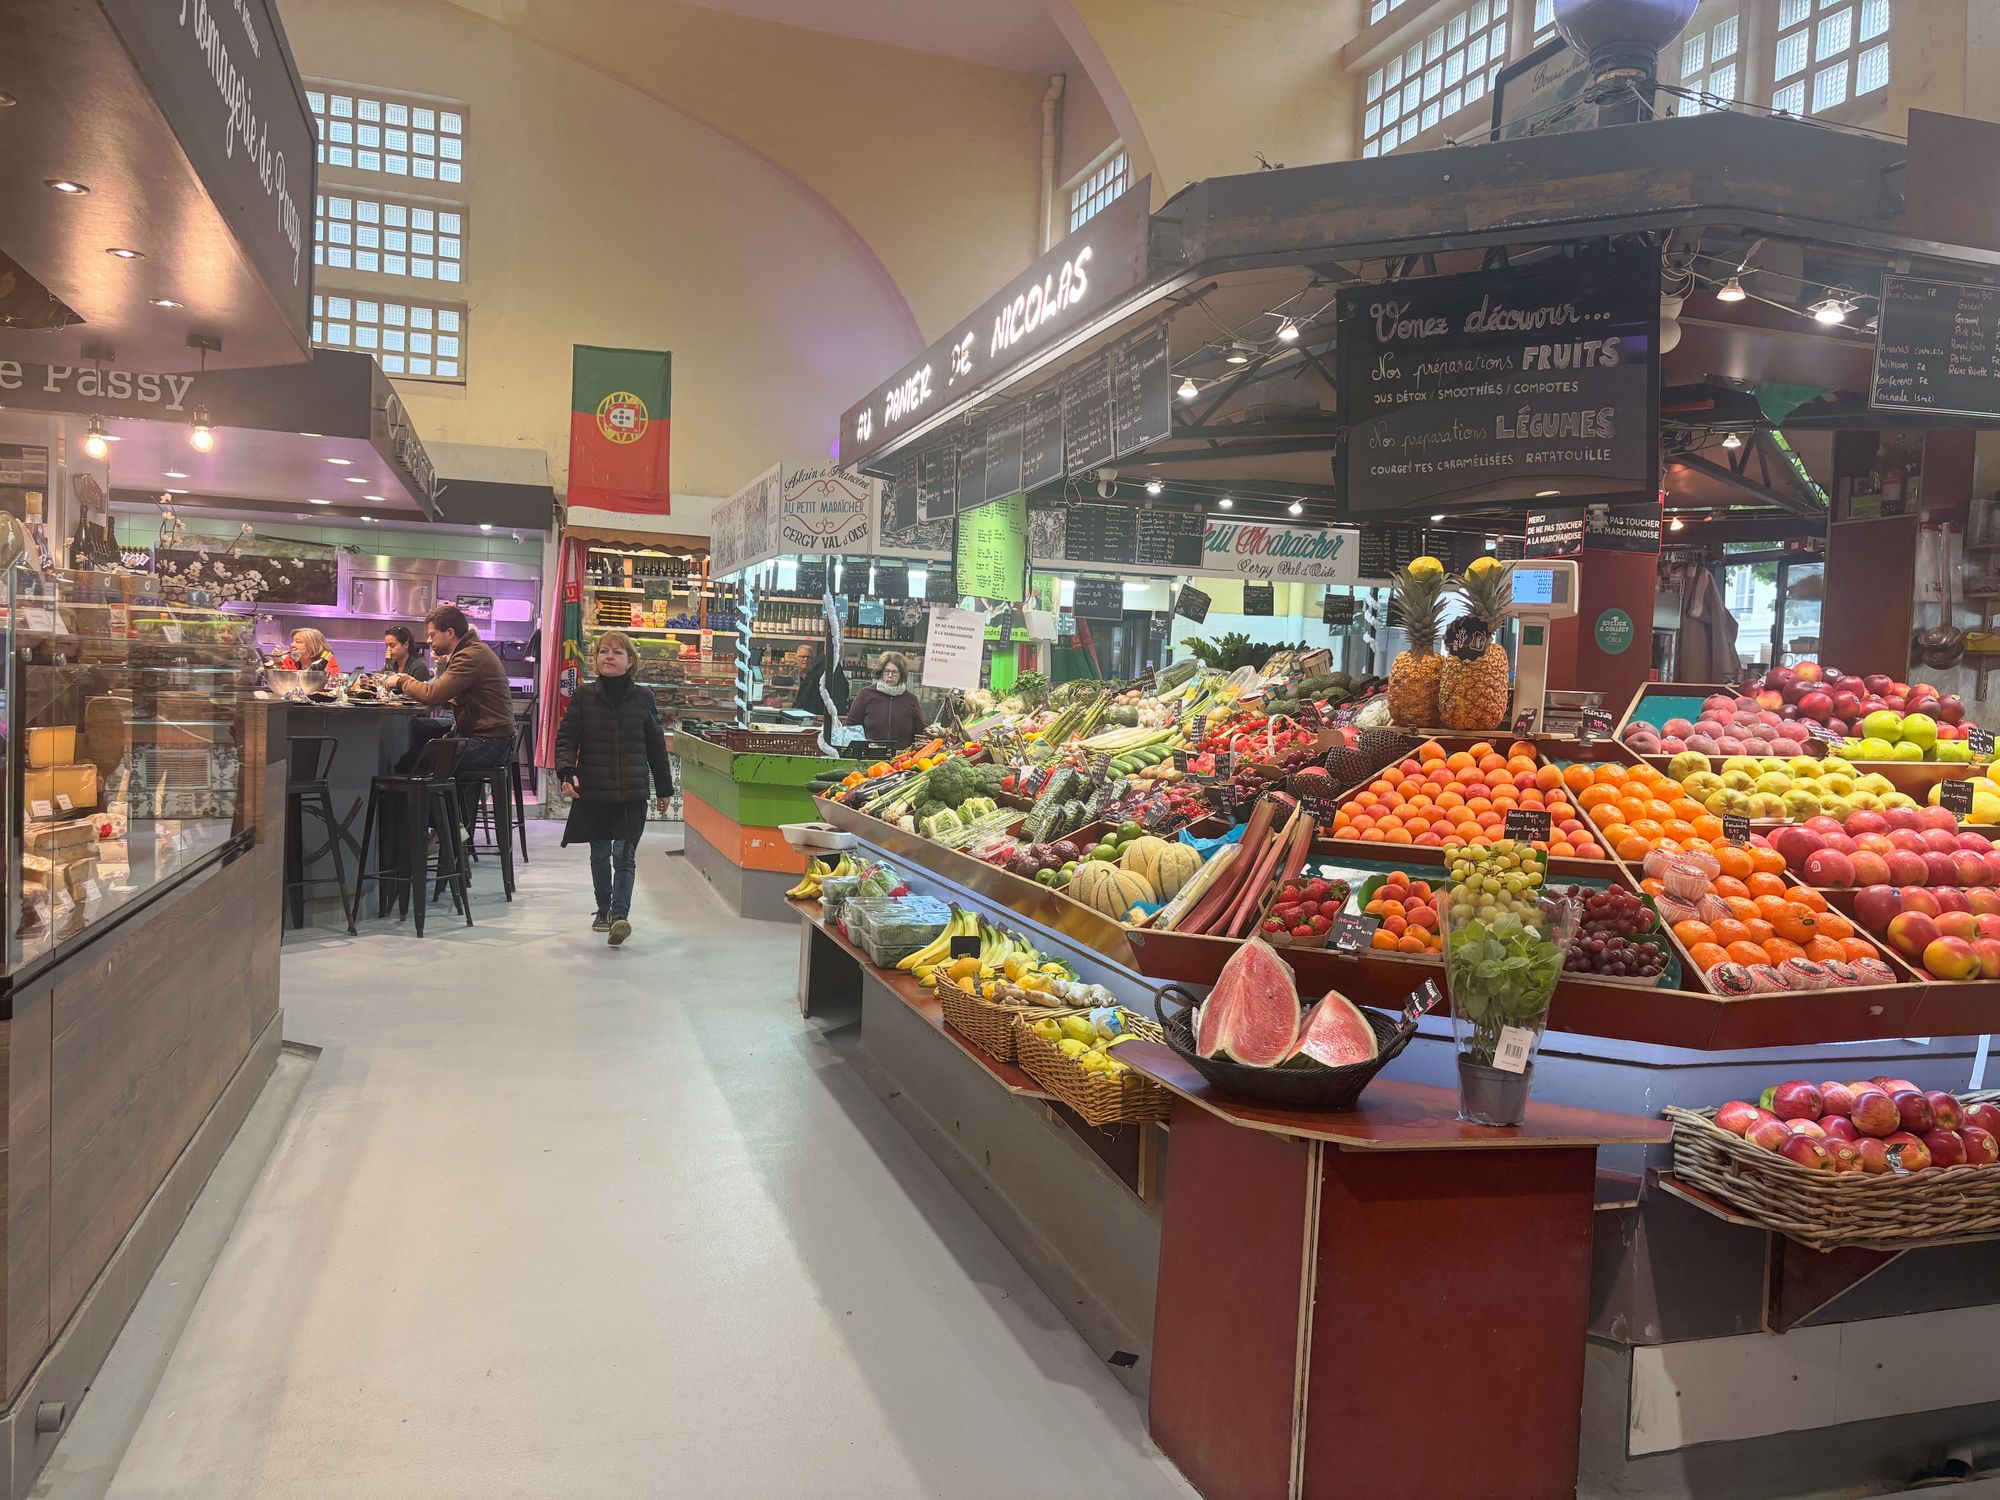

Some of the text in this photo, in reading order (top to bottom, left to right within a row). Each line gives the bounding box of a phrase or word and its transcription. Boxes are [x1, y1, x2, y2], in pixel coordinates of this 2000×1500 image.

[260, 121, 275, 197] de
[275, 151, 301, 287] Passy
[1927, 287, 1937, 297] FR
[1957, 299, 1984, 312] Golden
[1369, 300, 1449, 343] Venez
[1955, 312, 1979, 326] Granny
[856, 245, 1093, 444] AU PANIER DE NICOLAS
[1371, 336, 1621, 390] Nos préparations FRUITS
[1916, 362, 1927, 372] FR
[42, 363, 195, 411] Passy
[1919, 376, 1929, 386] FR
[1374, 393, 1394, 405] JUS
[1396, 389, 1428, 404] DÉTOX
[1437, 381, 1504, 401] SMOOTHIES
[1513, 380, 1579, 395] COMPOTES
[1877, 387, 1910, 402] Grenade
[1369, 420, 1397, 450] Nos
[1495, 404, 1617, 441] LÉGUMES
[1437, 454, 1515, 473] CARAMÉLISÉES
[1526, 445, 1612, 465] RATATOUILLE
[784, 467, 819, 492] Alain
[783, 498, 865, 514] AU PETIT MARAÎCHER
[1527, 514, 1546, 525] MERCI
[1527, 520, 1583, 536] DE NE PAS TOUCHER
[1609, 516, 1624, 526] PAS
[1625, 517, 1660, 529] TOUCHER
[782, 526, 819, 549] CERGY
[821, 536, 842, 549] VAL
[1235, 523, 1344, 561] Maraîcher
[1532, 536, 1539, 545] LA
[1539, 531, 1582, 544] MARCHANDISE
[1604, 527, 1660, 540] MARCHANDISE
[1237, 558, 1273, 577] Cergy
[1277, 560, 1301, 576] Val
